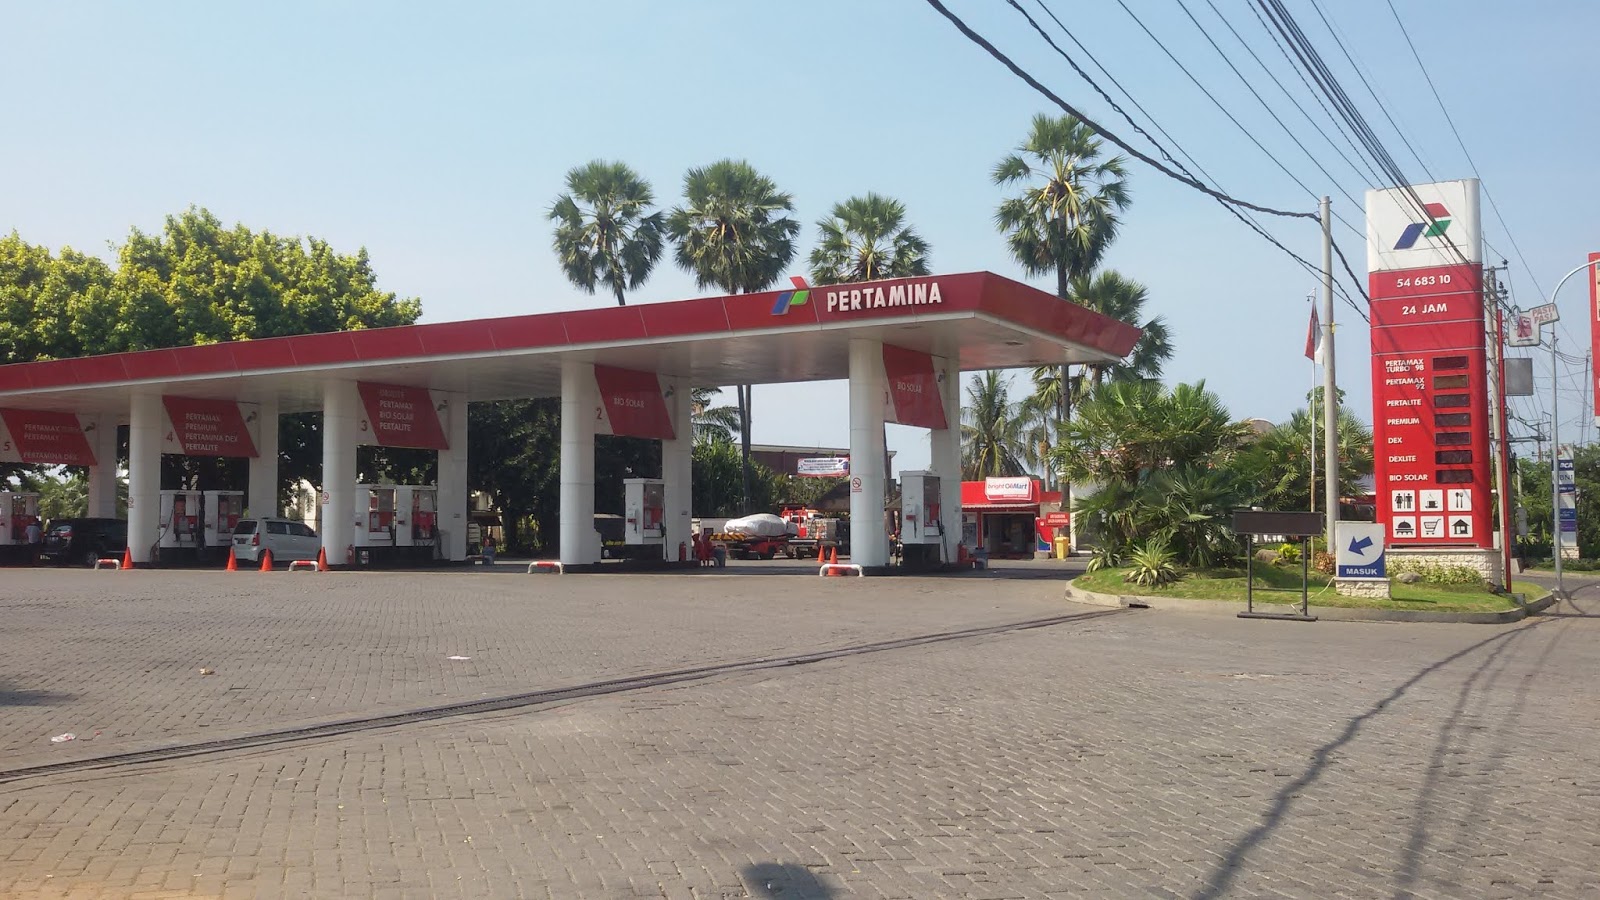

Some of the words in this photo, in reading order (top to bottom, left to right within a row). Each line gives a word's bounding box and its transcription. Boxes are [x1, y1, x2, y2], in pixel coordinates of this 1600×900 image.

[1396, 278, 1411, 288] 54
[1414, 276, 1436, 286] 683
[1439, 274, 1451, 284] 10
[827, 282, 942, 312] PERTAMINA
[1402, 306, 1417, 315] 24
[1422, 303, 1448, 314] JAM
[1532, 305, 1555, 317] PASTI
[1385, 358, 1424, 367] PERTAMAX
[1385, 377, 1425, 386] PERTAMAX
[379, 399, 414, 410] PERTAMAX
[1386, 398, 1422, 407] PERTALITE
[185, 412, 221, 422] PERTAMAX
[596, 407, 602, 420] 2
[361, 420, 368, 432] 3
[1387, 417, 1420, 425] PREMIUM
[185, 422, 217, 432] PREMIUM
[379, 421, 412, 432] PERTALITE
[166, 431, 174, 442] 4
[185, 432, 224, 442] PERTAMINA
[3, 441, 11, 451] 5
[185, 442, 219, 452] PERTALITE
[1388, 455, 1417, 463] DEXLITE
[1404, 473, 1428, 481] SOLAR
